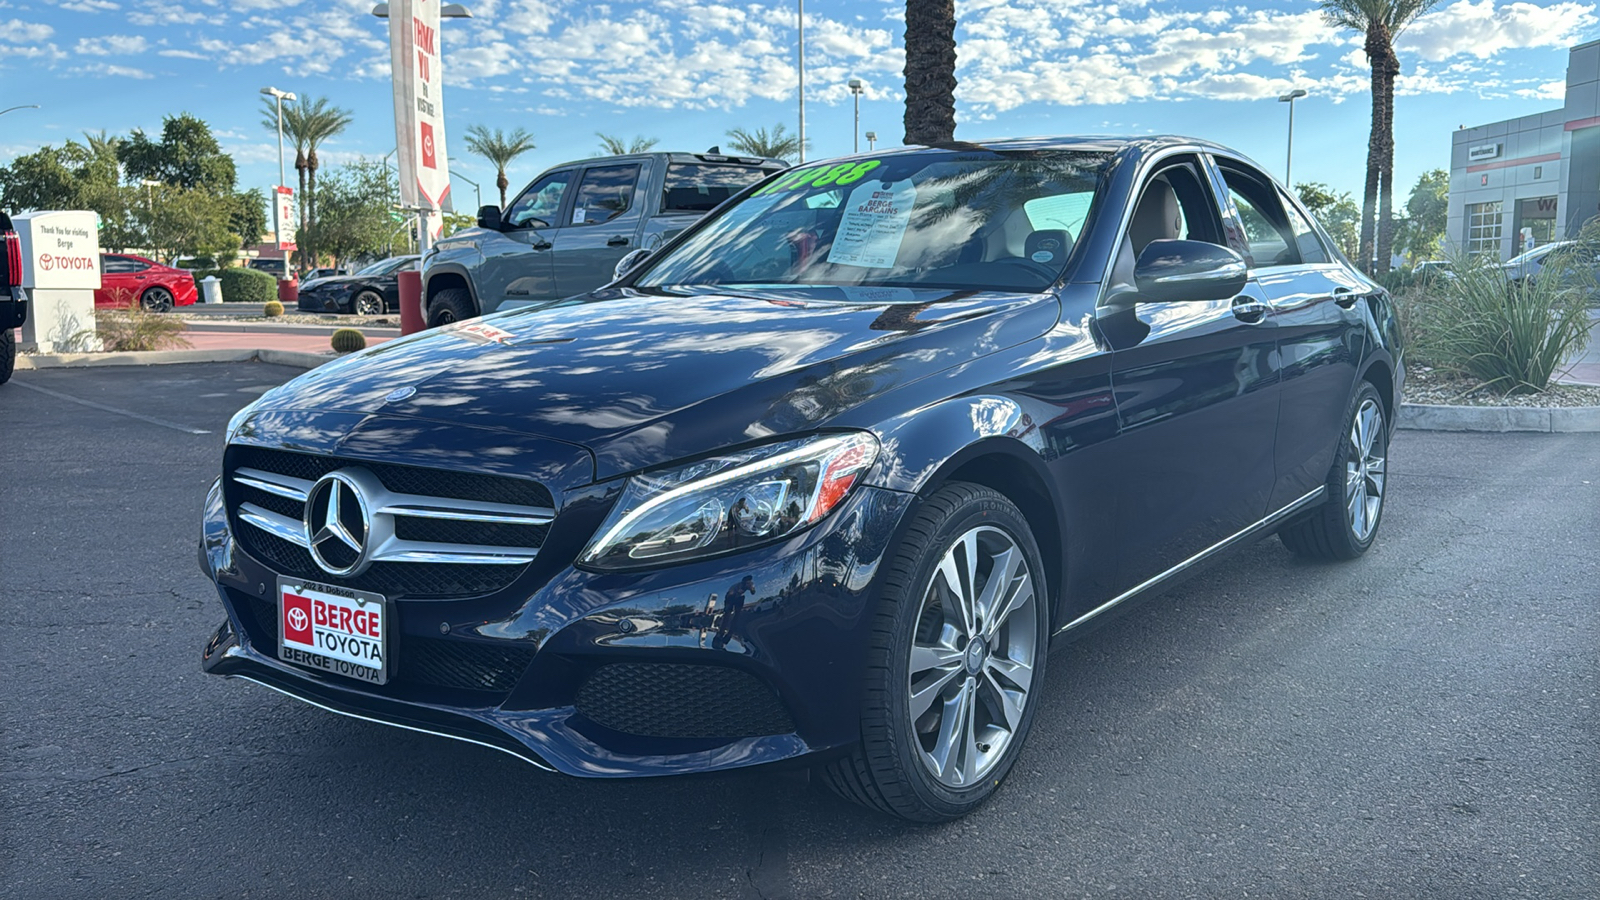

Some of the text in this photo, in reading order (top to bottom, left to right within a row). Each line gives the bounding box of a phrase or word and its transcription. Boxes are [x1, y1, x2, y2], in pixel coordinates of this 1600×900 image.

[858, 206, 898, 215] BARGAINS
[867, 200, 893, 208] BERGE
[40, 225, 54, 234] Thank
[56, 226, 64, 235] You
[72, 228, 88, 238] visiting
[57, 238, 73, 250] Berge
[55, 256, 94, 270] TOYOTA
[303, 581, 316, 590] 202
[325, 586, 355, 598] Dobson
[313, 600, 380, 637] BERGE
[315, 630, 382, 661] TOYOTA
[283, 647, 380, 682] BERGE TOYOTA
